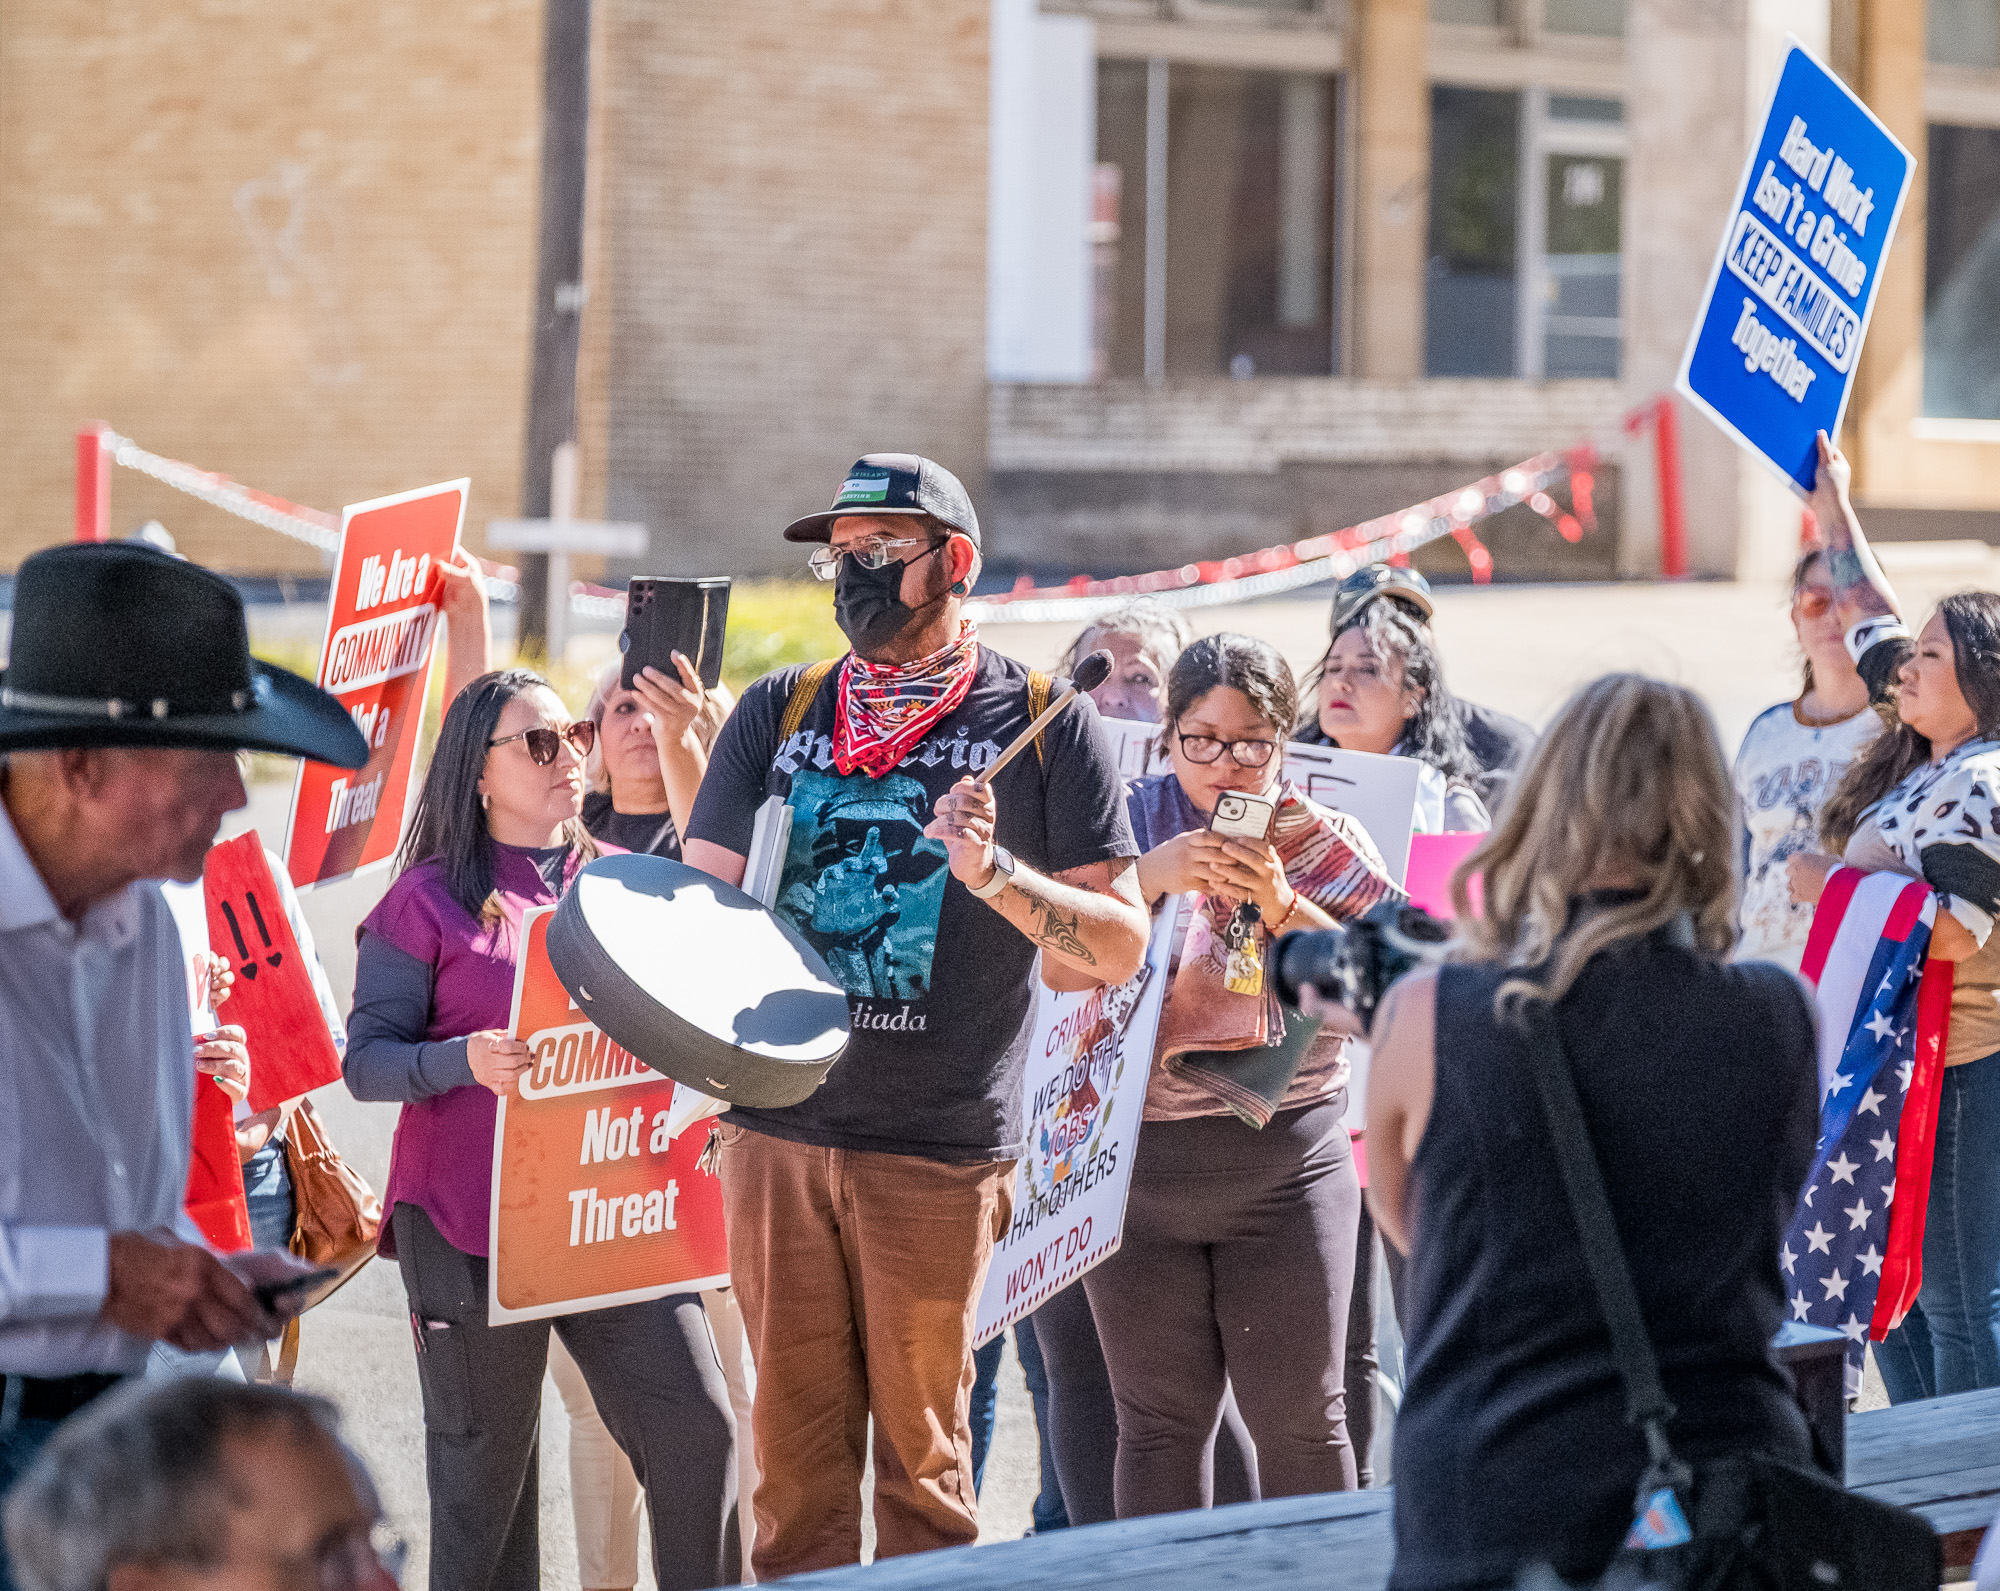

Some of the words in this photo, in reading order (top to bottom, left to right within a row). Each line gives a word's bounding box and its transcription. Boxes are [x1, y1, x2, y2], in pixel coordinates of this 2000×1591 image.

[1779, 114, 1835, 192] Hard
[1822, 154, 1875, 238] Work
[1752, 159, 1805, 237] Isn't
[1794, 208, 1817, 250] a
[1809, 214, 1867, 299] Crime
[1732, 220, 1783, 290] KEEP
[1774, 262, 1855, 362] FAMILIES
[1731, 297, 1816, 404] Together
[355, 553, 385, 612] We
[382, 548, 416, 606] Are
[413, 552, 431, 596] a
[330, 613, 433, 686] COMMUNITY
[374, 706, 390, 749] a
[325, 769, 382, 834] Threat
[1032, 1074, 1060, 1122] WE
[1060, 1052, 1089, 1099] DO
[1092, 1032, 1125, 1079] THE
[579, 1105, 645, 1166] Not
[649, 1110, 670, 1155] a
[1043, 1103, 1093, 1166] JOBS
[568, 1178, 680, 1248] Threat
[1048, 1141, 1119, 1216] OTHERS
[1005, 1235, 1065, 1305] WON'T
[1065, 1216, 1093, 1263] DO
